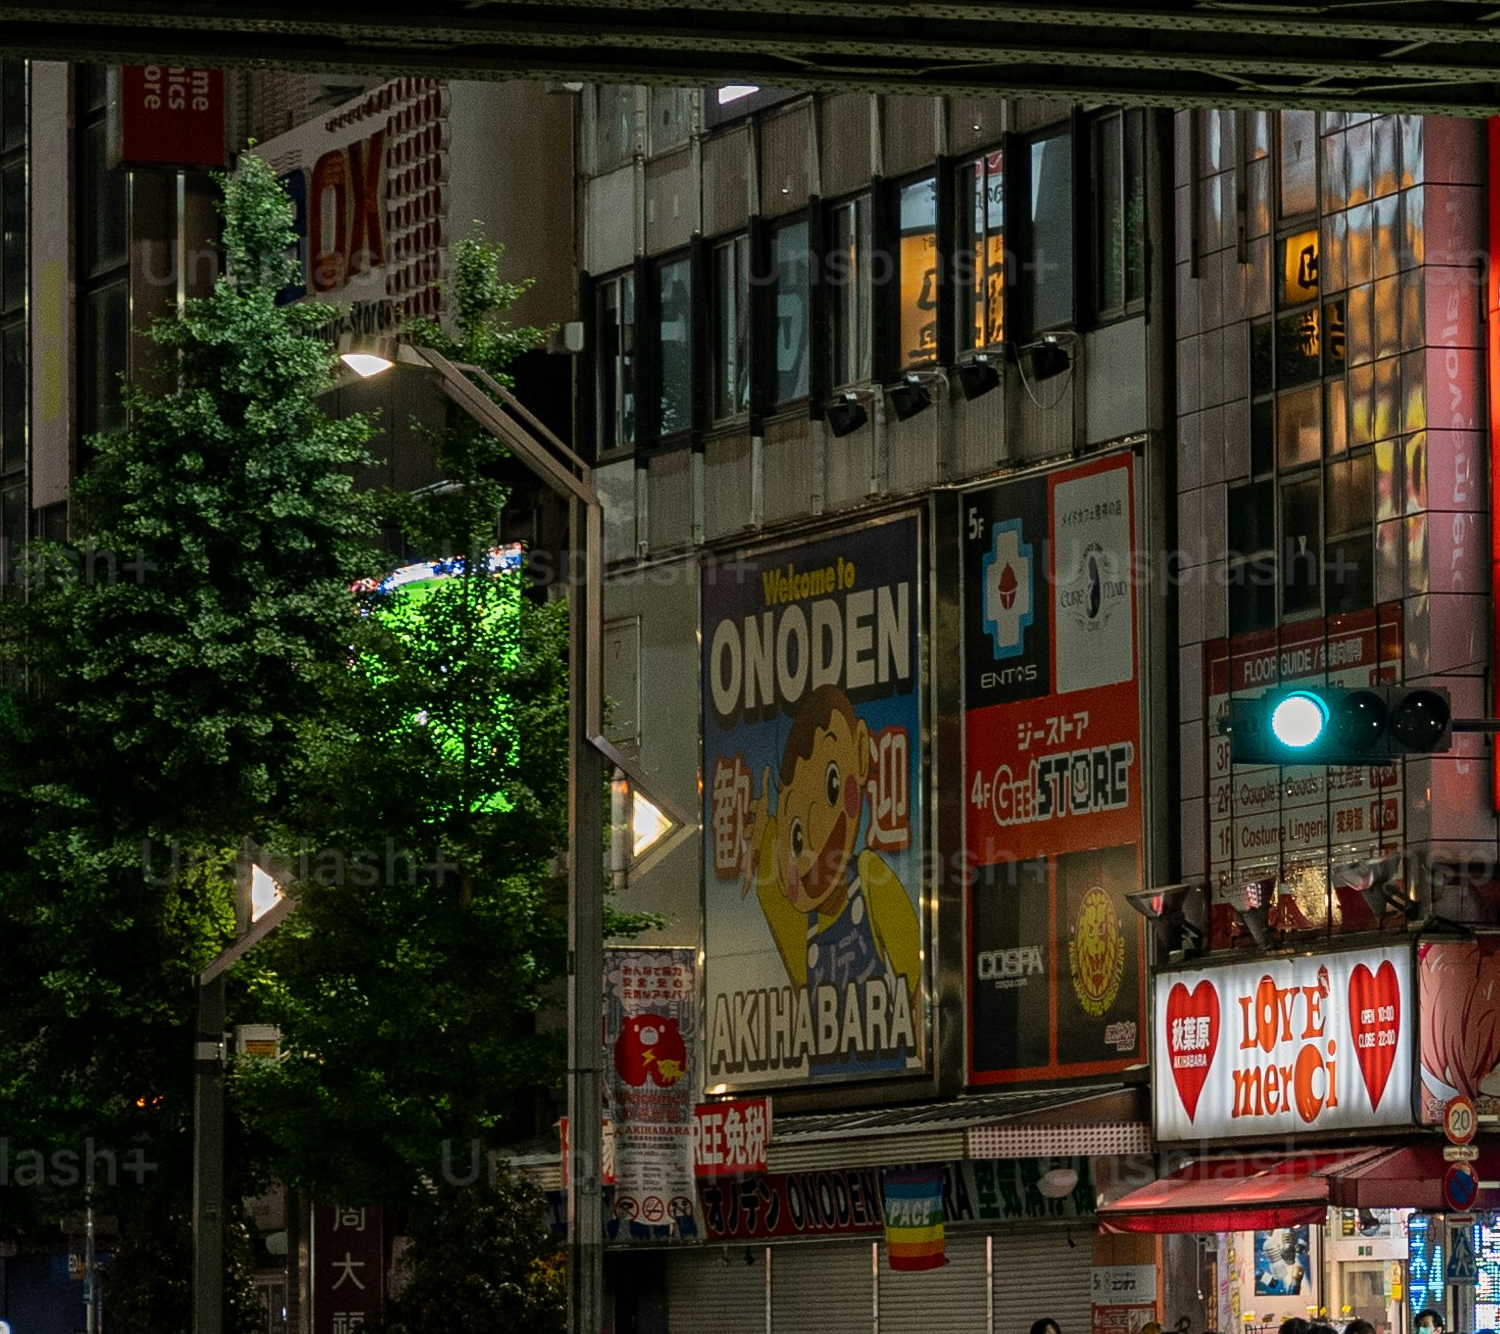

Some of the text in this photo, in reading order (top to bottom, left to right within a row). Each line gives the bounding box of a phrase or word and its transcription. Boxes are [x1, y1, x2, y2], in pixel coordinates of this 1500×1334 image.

[968, 507, 985, 540] 5F
[762, 555, 856, 606] Welcome to
[709, 581, 911, 717] ONODEN
[1243, 660, 1278, 685] FLOOR
[1280, 647, 1311, 675] GUIDE
[1017, 710, 1089, 751] ジーストア
[971, 770, 991, 810] 4F
[977, 945, 1045, 981] COSPA
[710, 975, 916, 1070] AKIHABARA
[1237, 972, 1328, 1055] LOVE
[1360, 1005, 1395, 1025] OPEN 10:00
[1171, 1016, 1211, 1053] 秋葉原
[1358, 1028, 1396, 1049] CLOSE 22:00
[1450, 1109, 1471, 1132] 20
[703, 1177, 779, 1235] オノデン
[786, 1166, 886, 1230] ONODEN
[889, 1199, 932, 1225] PACE
